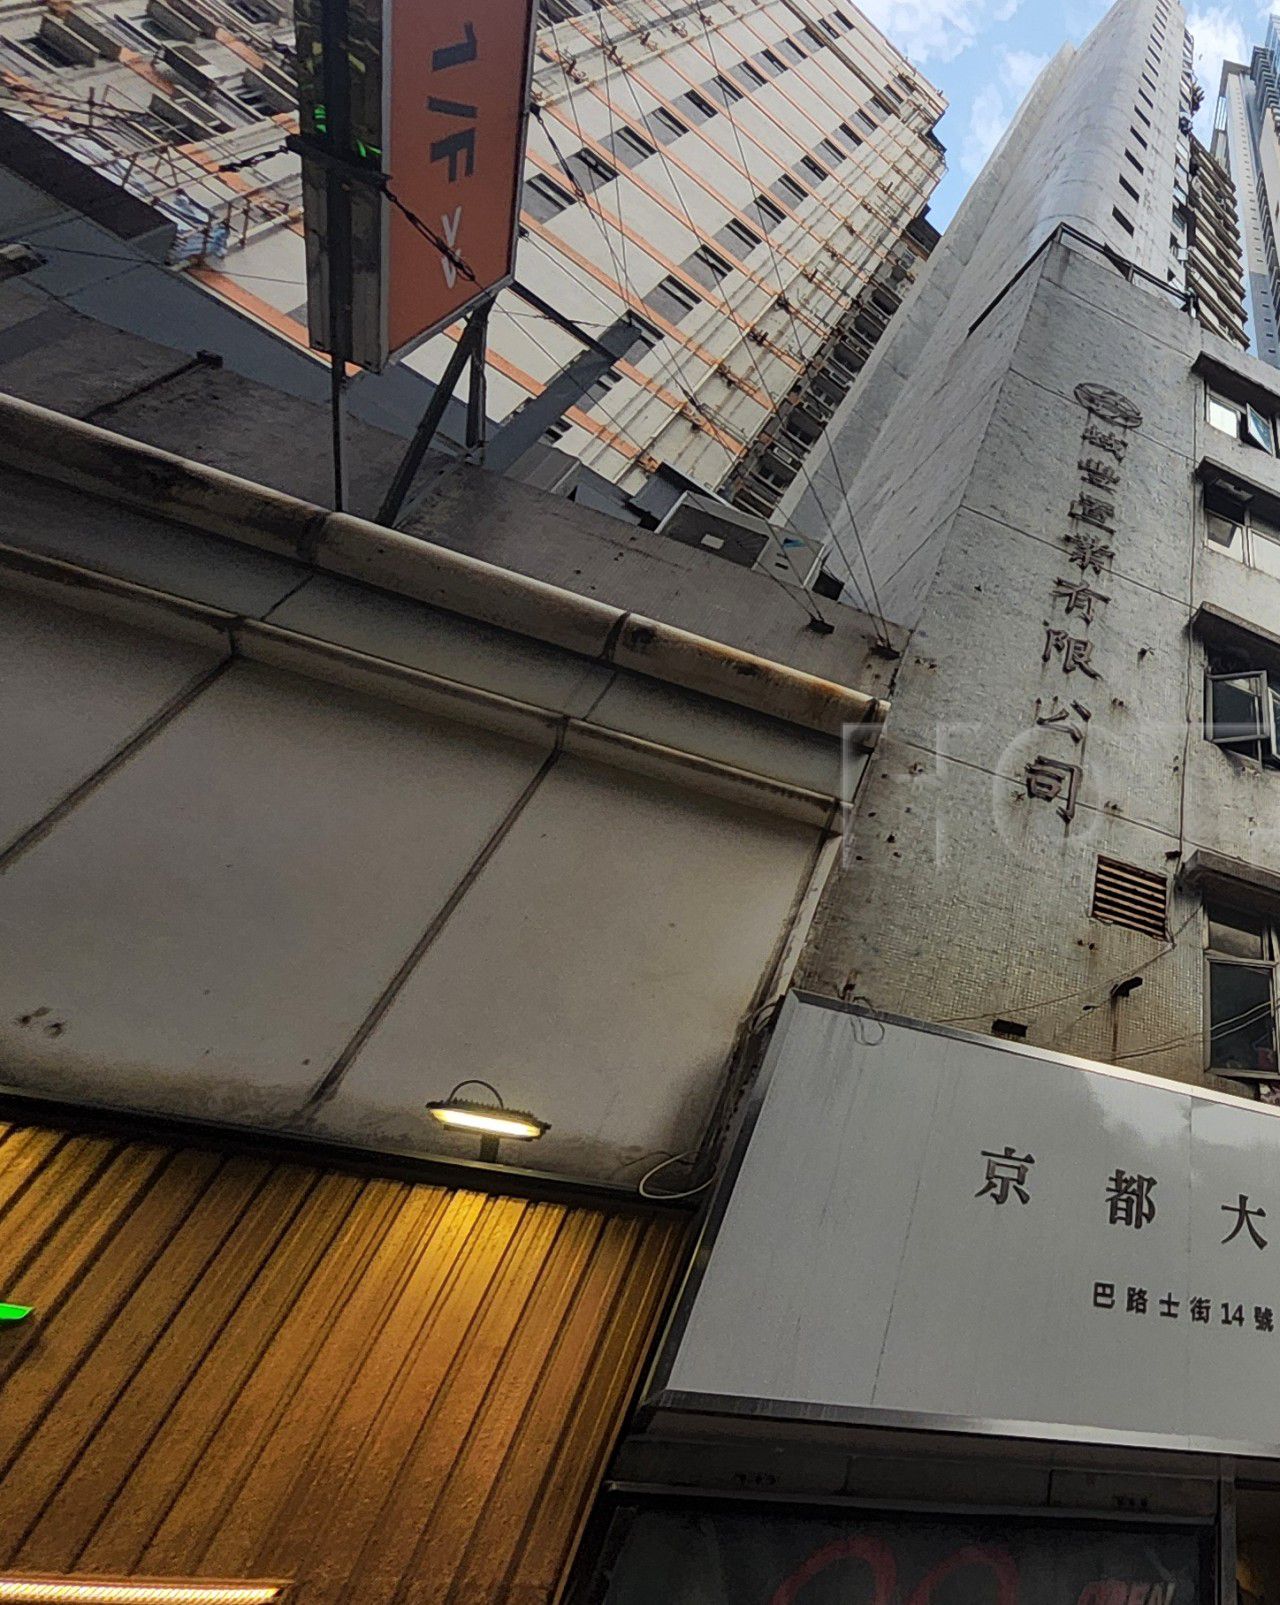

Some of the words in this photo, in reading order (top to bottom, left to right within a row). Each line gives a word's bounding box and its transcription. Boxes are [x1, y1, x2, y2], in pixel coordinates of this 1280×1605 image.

[1092, 1281, 1275, 1333] 巴路士街14號
